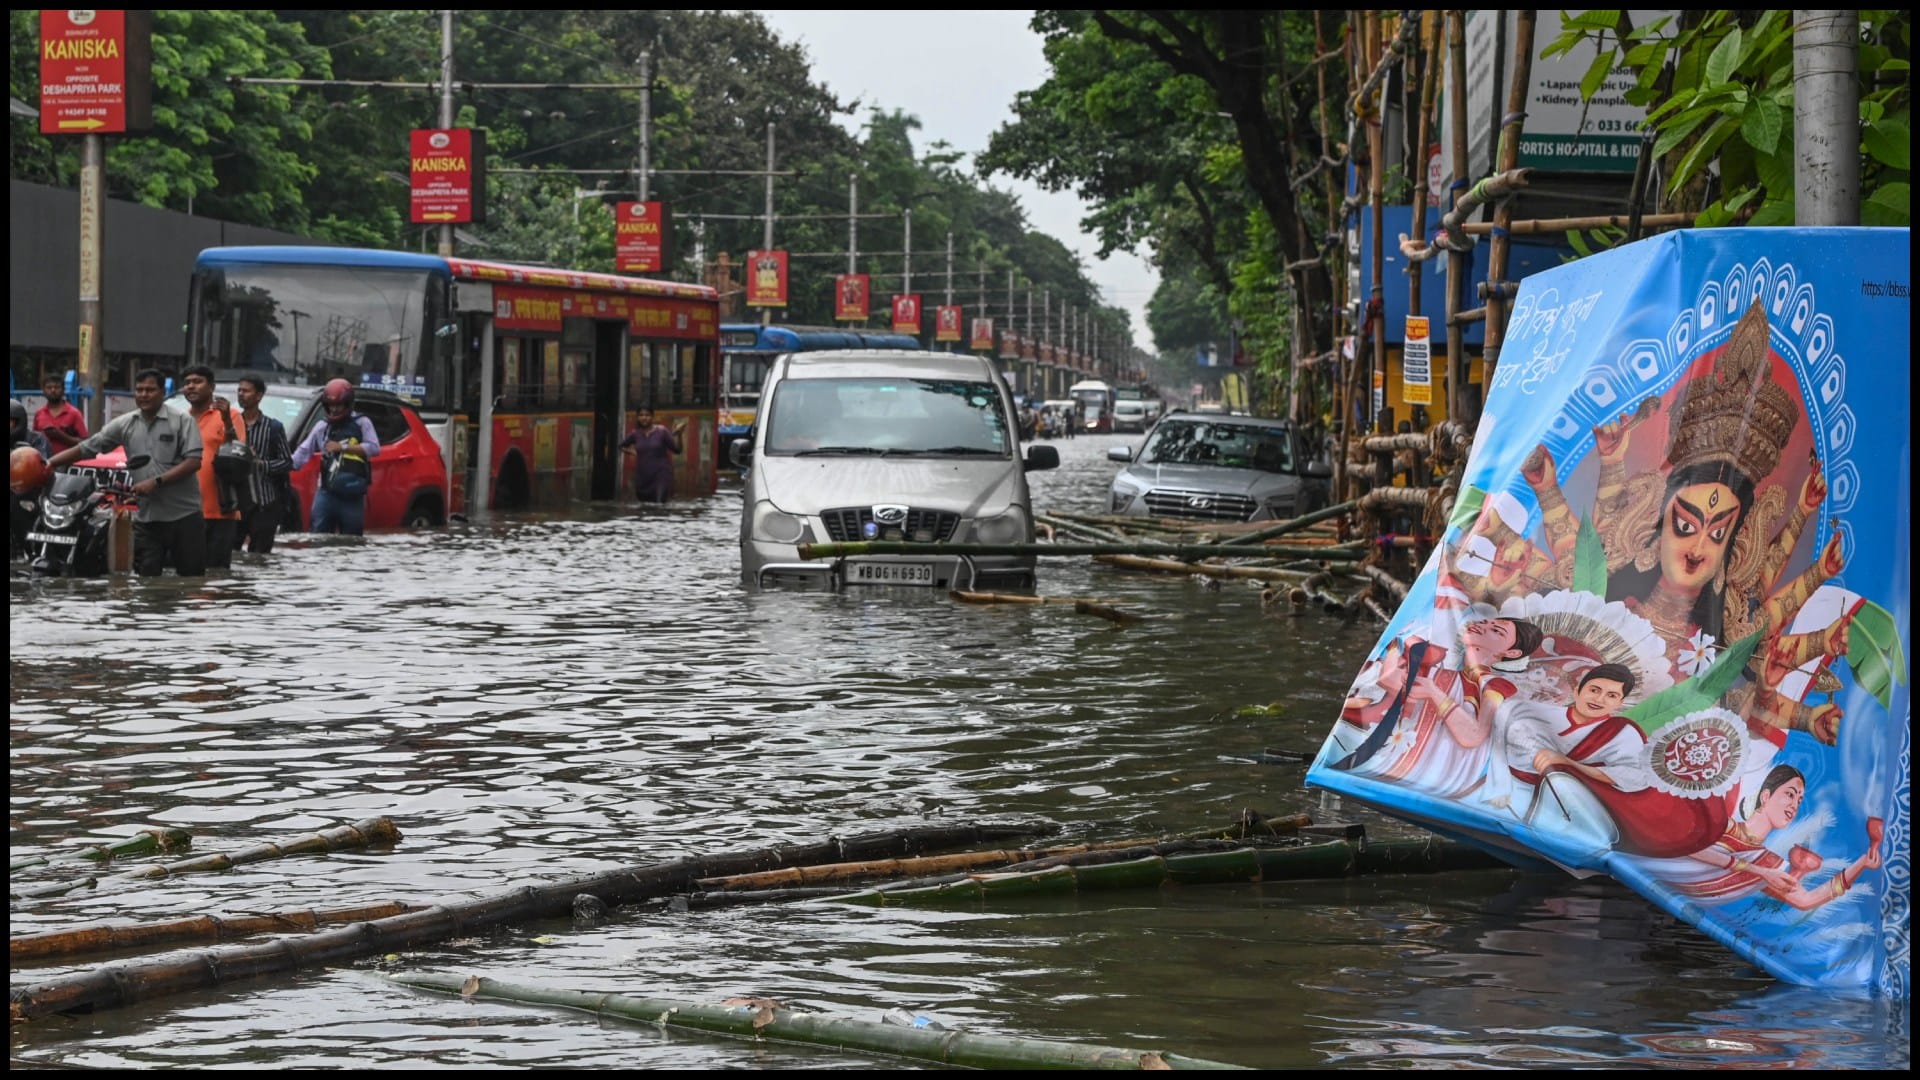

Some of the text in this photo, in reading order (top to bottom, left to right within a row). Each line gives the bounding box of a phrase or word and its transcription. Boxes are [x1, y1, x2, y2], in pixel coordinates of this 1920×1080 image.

[44, 38, 119, 59] KANISKA
[65, 75, 99, 83] OPPOSITE
[43, 84, 121, 95] DESHAPRIYA PARK
[1542, 94, 1579, 107] Kidney
[1598, 120, 1622, 131] 033
[1556, 142, 1609, 157] HOSPITAL
[1610, 143, 1619, 157] &
[412, 157, 467, 173] KANISKA
[617, 223, 658, 234] KANISKA
[381, 374, 406, 385] S-5
[858, 566, 931, 581] WB 06 H 6930
